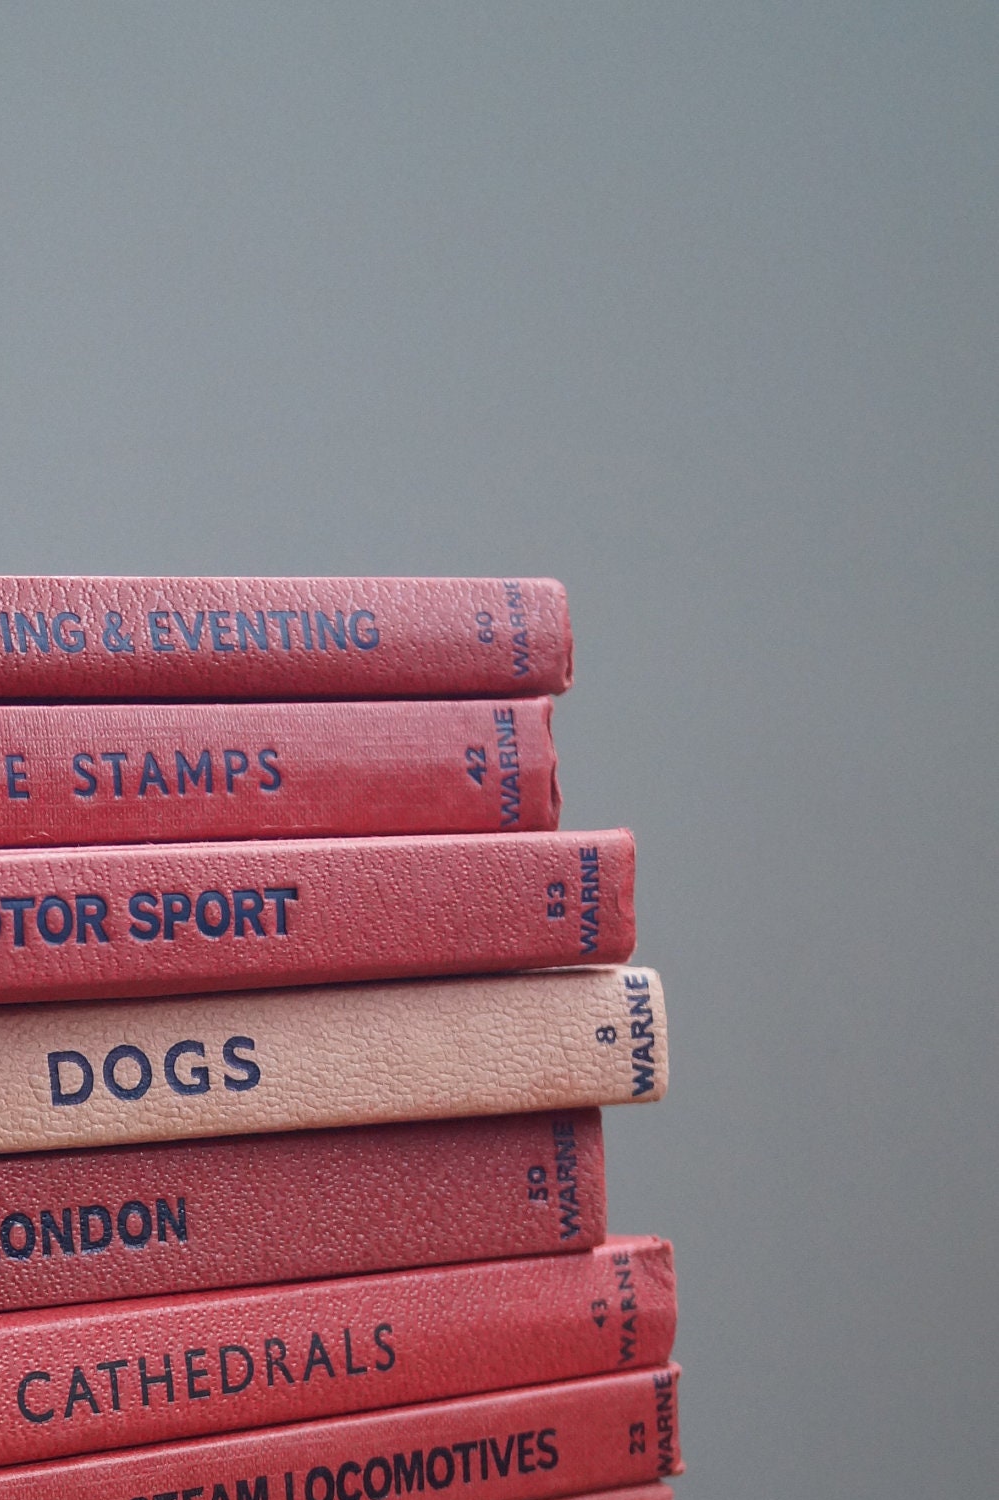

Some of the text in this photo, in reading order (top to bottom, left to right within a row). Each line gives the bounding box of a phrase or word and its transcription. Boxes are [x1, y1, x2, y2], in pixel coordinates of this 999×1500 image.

[102, 611, 134, 653] &
[150, 609, 381, 652] EVENTING
[475, 611, 494, 645] 60
[504, 579, 530, 678] WARNE
[73, 749, 283, 799] STAMPS
[465, 746, 487, 786] 42
[493, 706, 520, 827] WARNE
[128, 888, 299, 942] SPORT
[547, 881, 566, 920] 53
[579, 847, 600, 956] WARNE
[595, 1025, 617, 1045] 8
[623, 973, 655, 1098] WARNE
[47, 1036, 262, 1107] DOGS
[527, 1165, 548, 1202] 50
[553, 1119, 581, 1241] WARNE
[591, 1297, 608, 1329] 43
[613, 1250, 637, 1366] WARNE
[16, 1323, 397, 1424] CATHEDRALS
[628, 1421, 646, 1456] 23
[653, 1371, 676, 1477] WARNE
